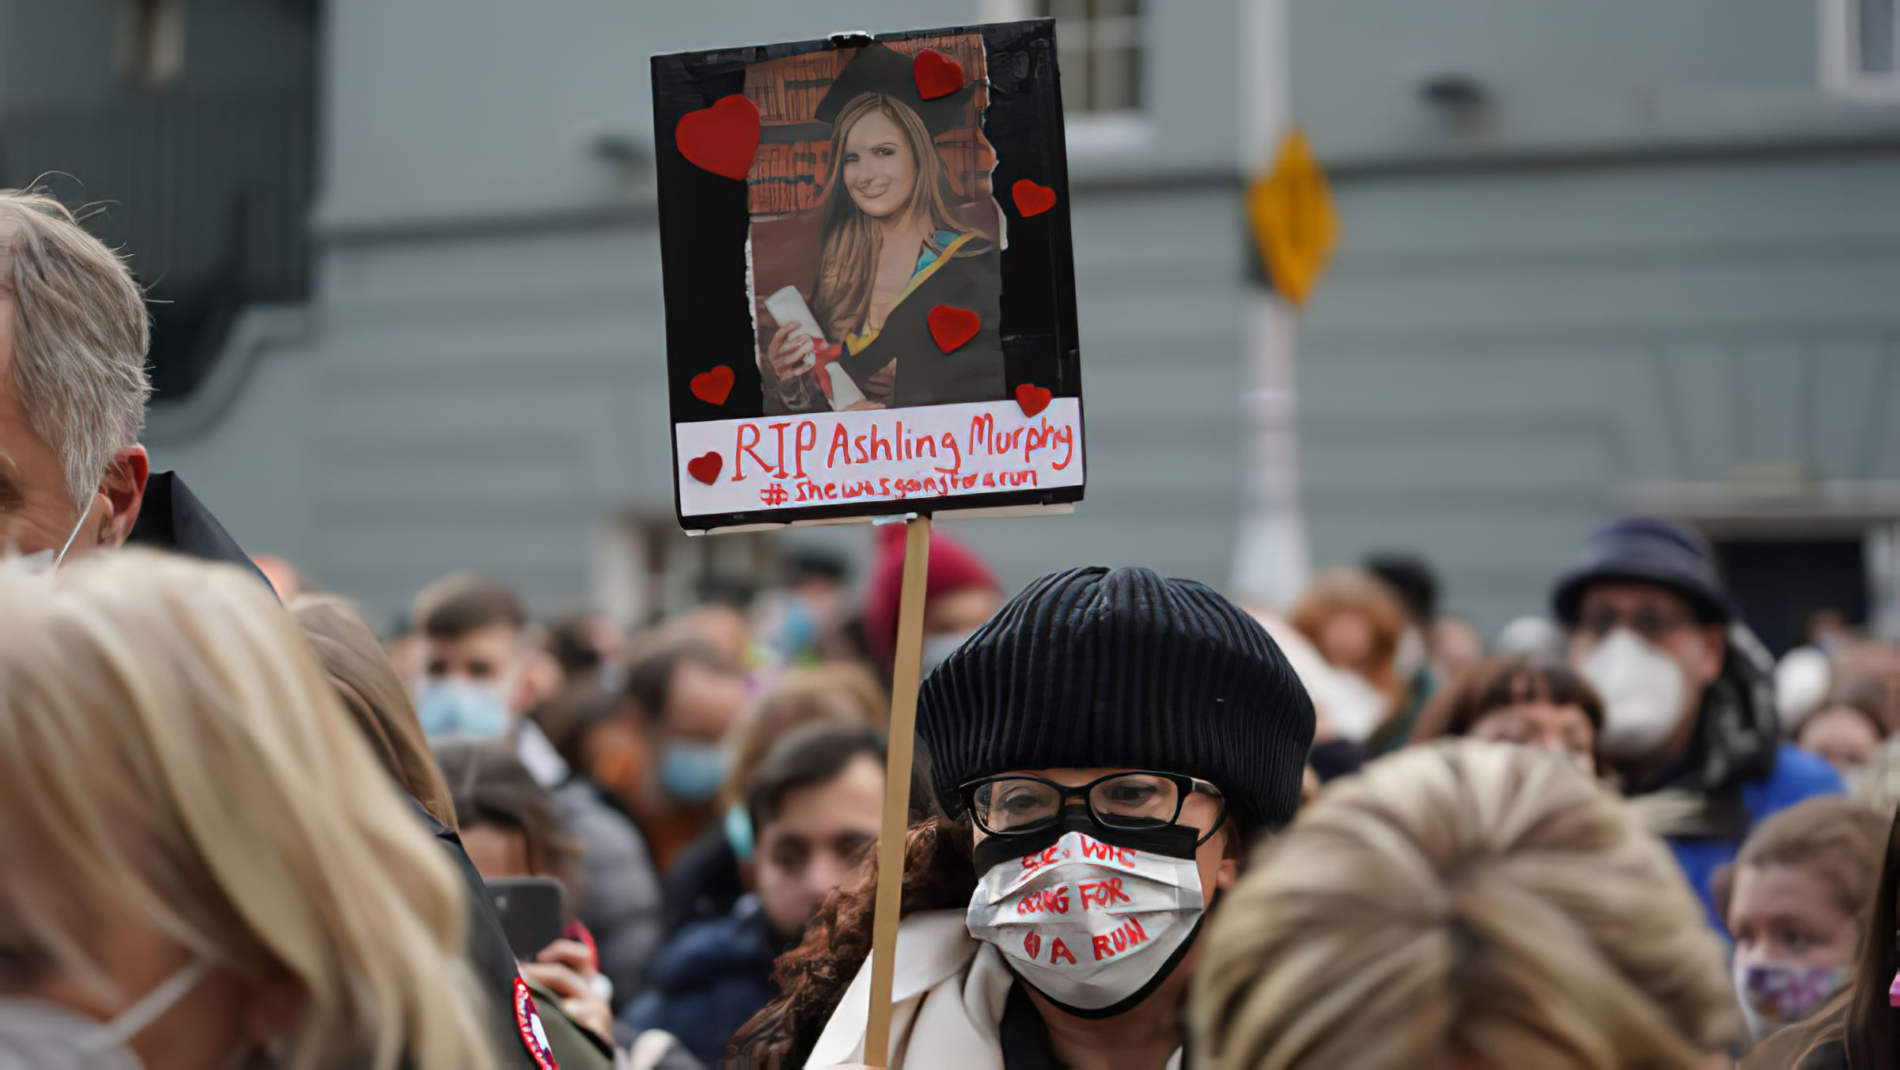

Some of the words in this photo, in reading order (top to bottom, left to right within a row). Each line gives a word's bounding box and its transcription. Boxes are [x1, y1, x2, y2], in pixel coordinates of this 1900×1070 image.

[731, 420, 816, 482] RIP
[827, 421, 961, 474] Ashling
[968, 412, 1073, 471] Murphy
[1078, 877, 1132, 912] FOR
[1050, 937, 1077, 965] A
[1092, 916, 1150, 961] RUN
